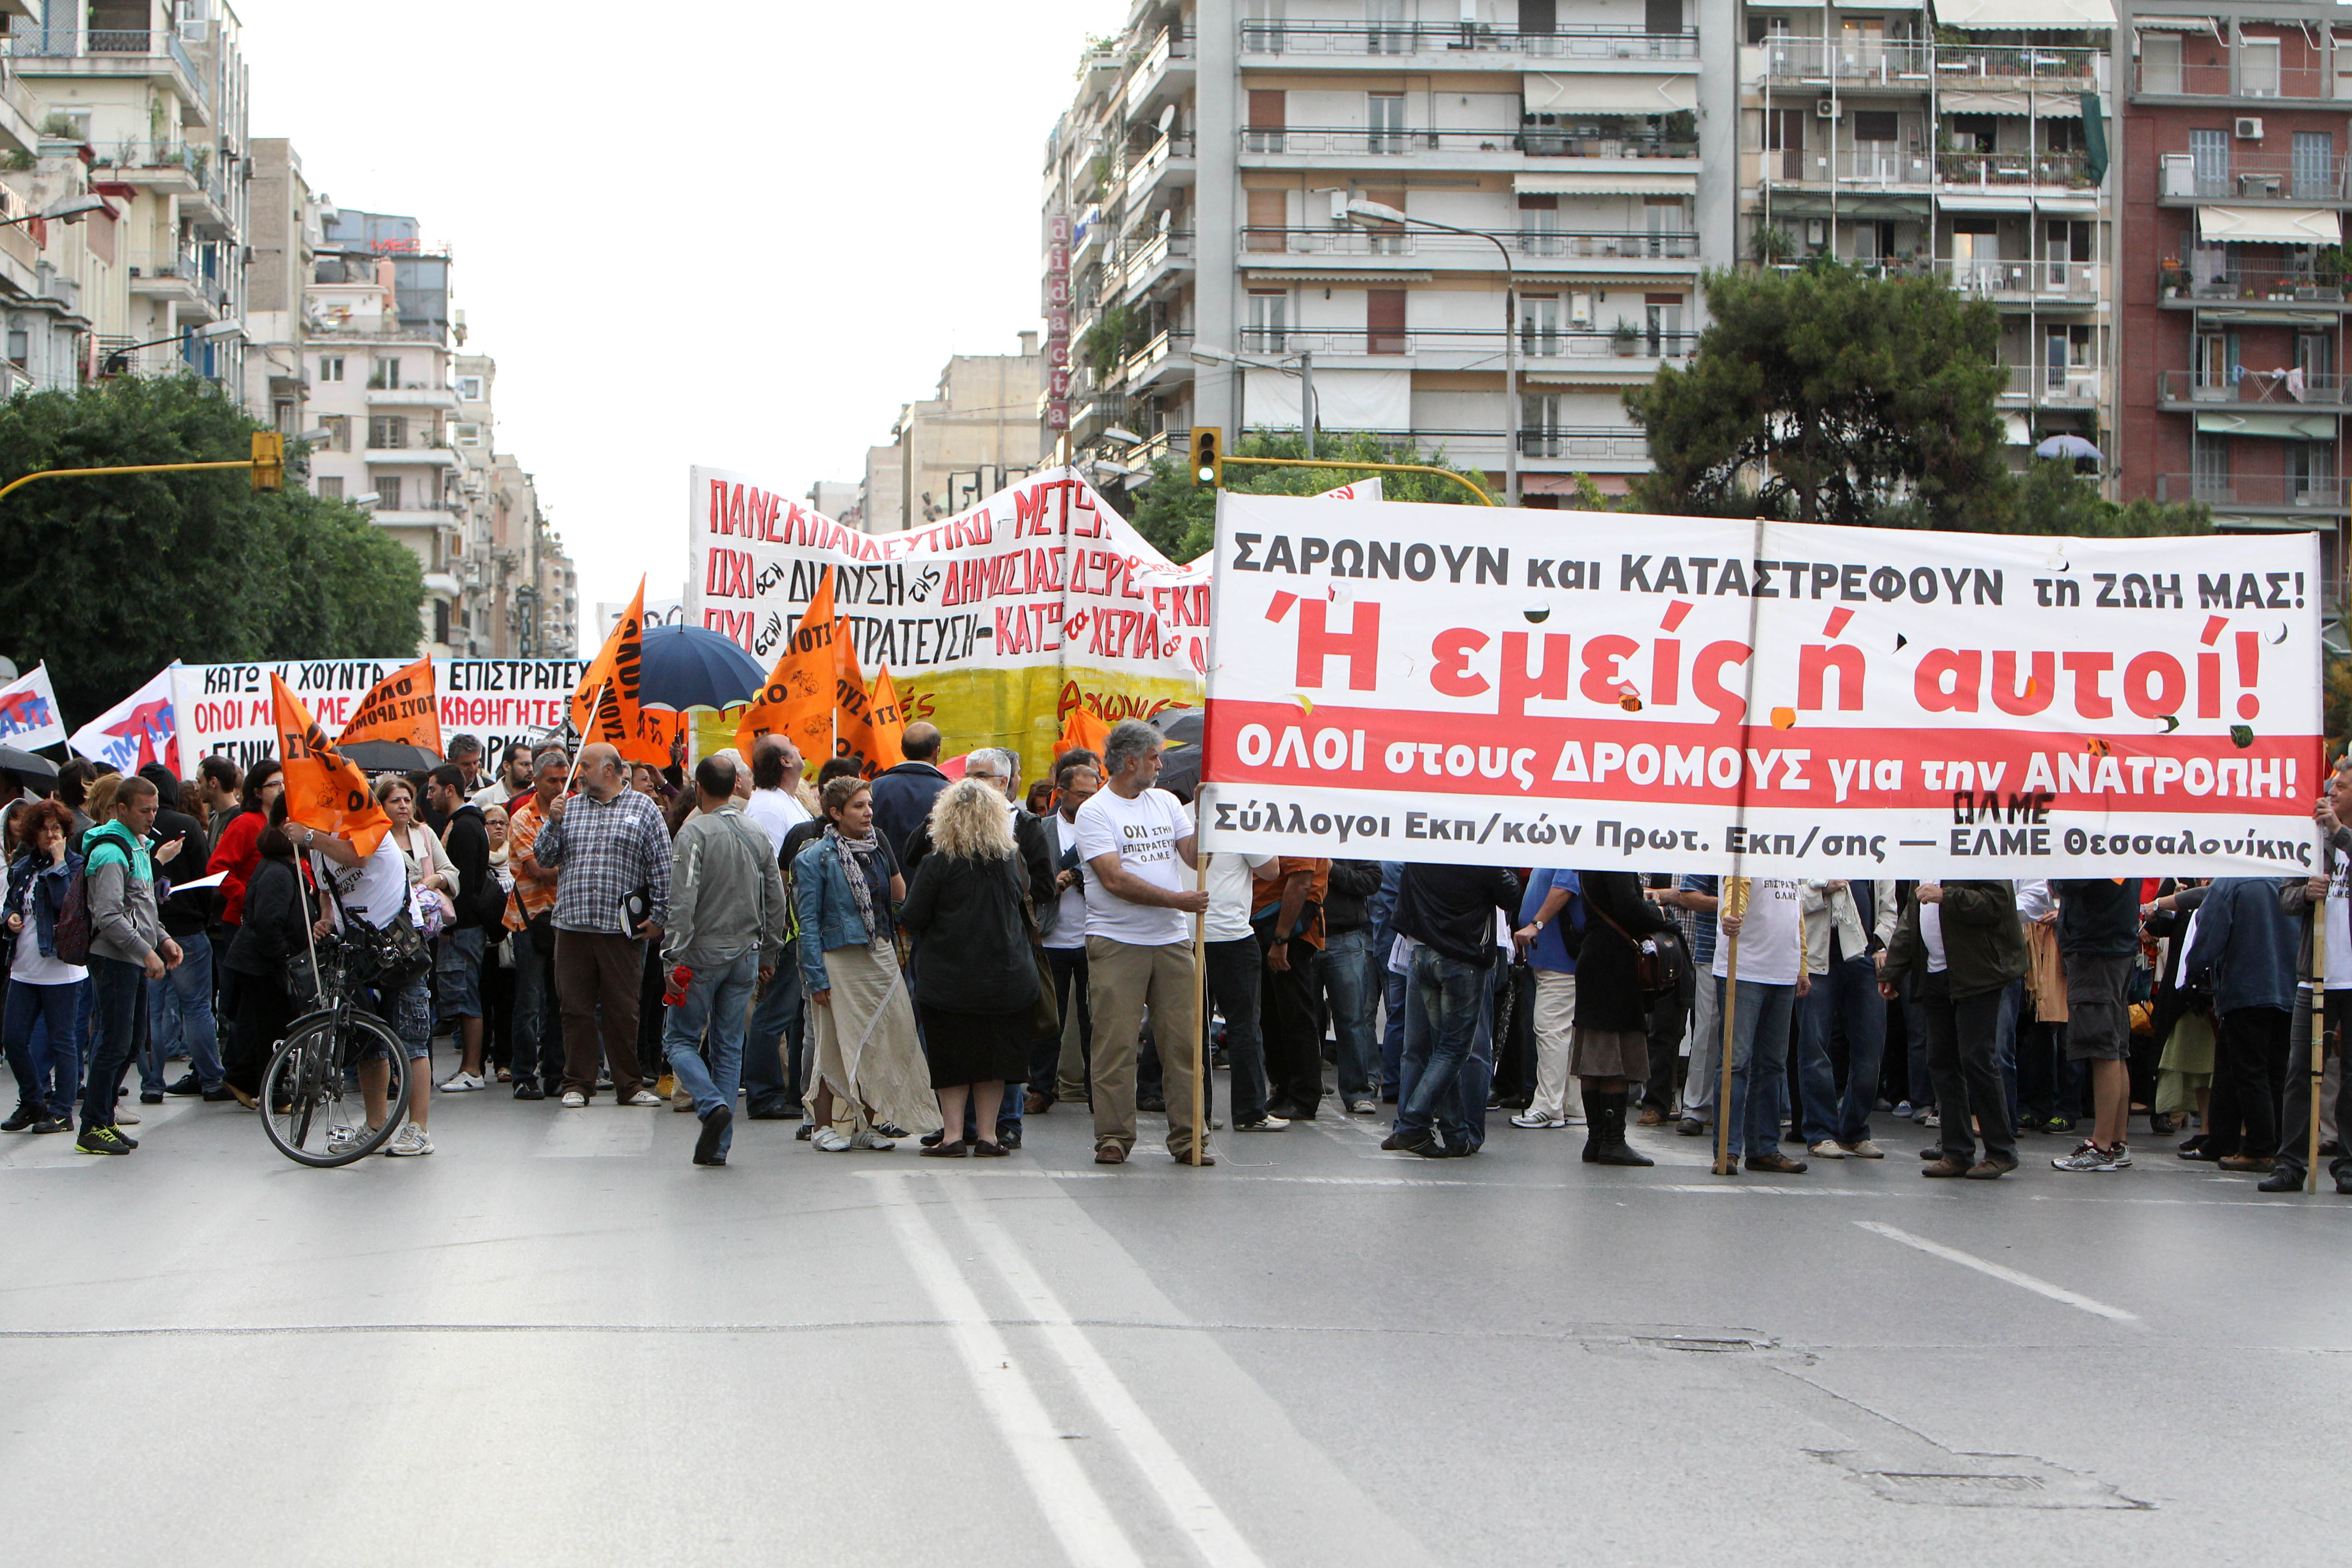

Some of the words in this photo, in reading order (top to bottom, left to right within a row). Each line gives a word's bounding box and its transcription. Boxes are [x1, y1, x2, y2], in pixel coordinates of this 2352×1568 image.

[1051, 220, 1067, 425] didacta
[710, 479, 992, 561] ΠΑΝΕΚΠΑΙΔΕΥΤΙΚΟ
[706, 548, 754, 599] ΟΧΙ
[942, 547, 1066, 606] ΔΗΜΟΣΙΑΣ
[1070, 548, 1144, 600] ΔΩΡΕ
[1234, 533, 1509, 585] ΣΑΡΩΝΟΥΝ
[1528, 559, 1600, 590] και
[1620, 555, 2003, 605] ΚΑΤΑΣΤΡΕΦΟΥΝ
[2033, 579, 2080, 607] τη
[2093, 574, 2183, 608] ΖΩΗ
[2198, 572, 2304, 609] ΜΑΣ!
[1063, 608, 1090, 640] τα
[1089, 606, 1159, 659] ΧΕΡΙΑ
[1430, 600, 1754, 725] εμείς
[1797, 606, 1866, 711] ή
[1914, 615, 2260, 721] αυτοί!
[205, 666, 259, 694] ΚΑΤΩ
[298, 662, 384, 691] ΧΟΥΝΤΑ
[316, 697, 351, 725] ΜΕ
[1237, 723, 1365, 771] ΟΛΟΙ
[1384, 741, 1537, 791] στους
[1551, 740, 1811, 791] ΔΡΟΜΟΥΣ
[1827, 759, 1903, 804] για
[1920, 760, 2007, 791] την
[2021, 752, 2297, 799] ΑΝΑΤΡΟΠΗ!
[1124, 825, 1148, 839] ΟΧΙ
[1152, 825, 1173, 836] ΣΤΗΝ
[1214, 800, 1390, 845] Σύλλογοι
[1406, 813, 1581, 846] Εκπ/κών
[1596, 821, 1709, 856] Πρωτ.
[1726, 827, 1886, 863] Εκπ/σης
[1950, 829, 2051, 856] ΕΛΜΕ
[2064, 828, 2311, 868] Θεσσαλονίκης
[1954, 791, 2055, 825] ΟΛΜΕ
